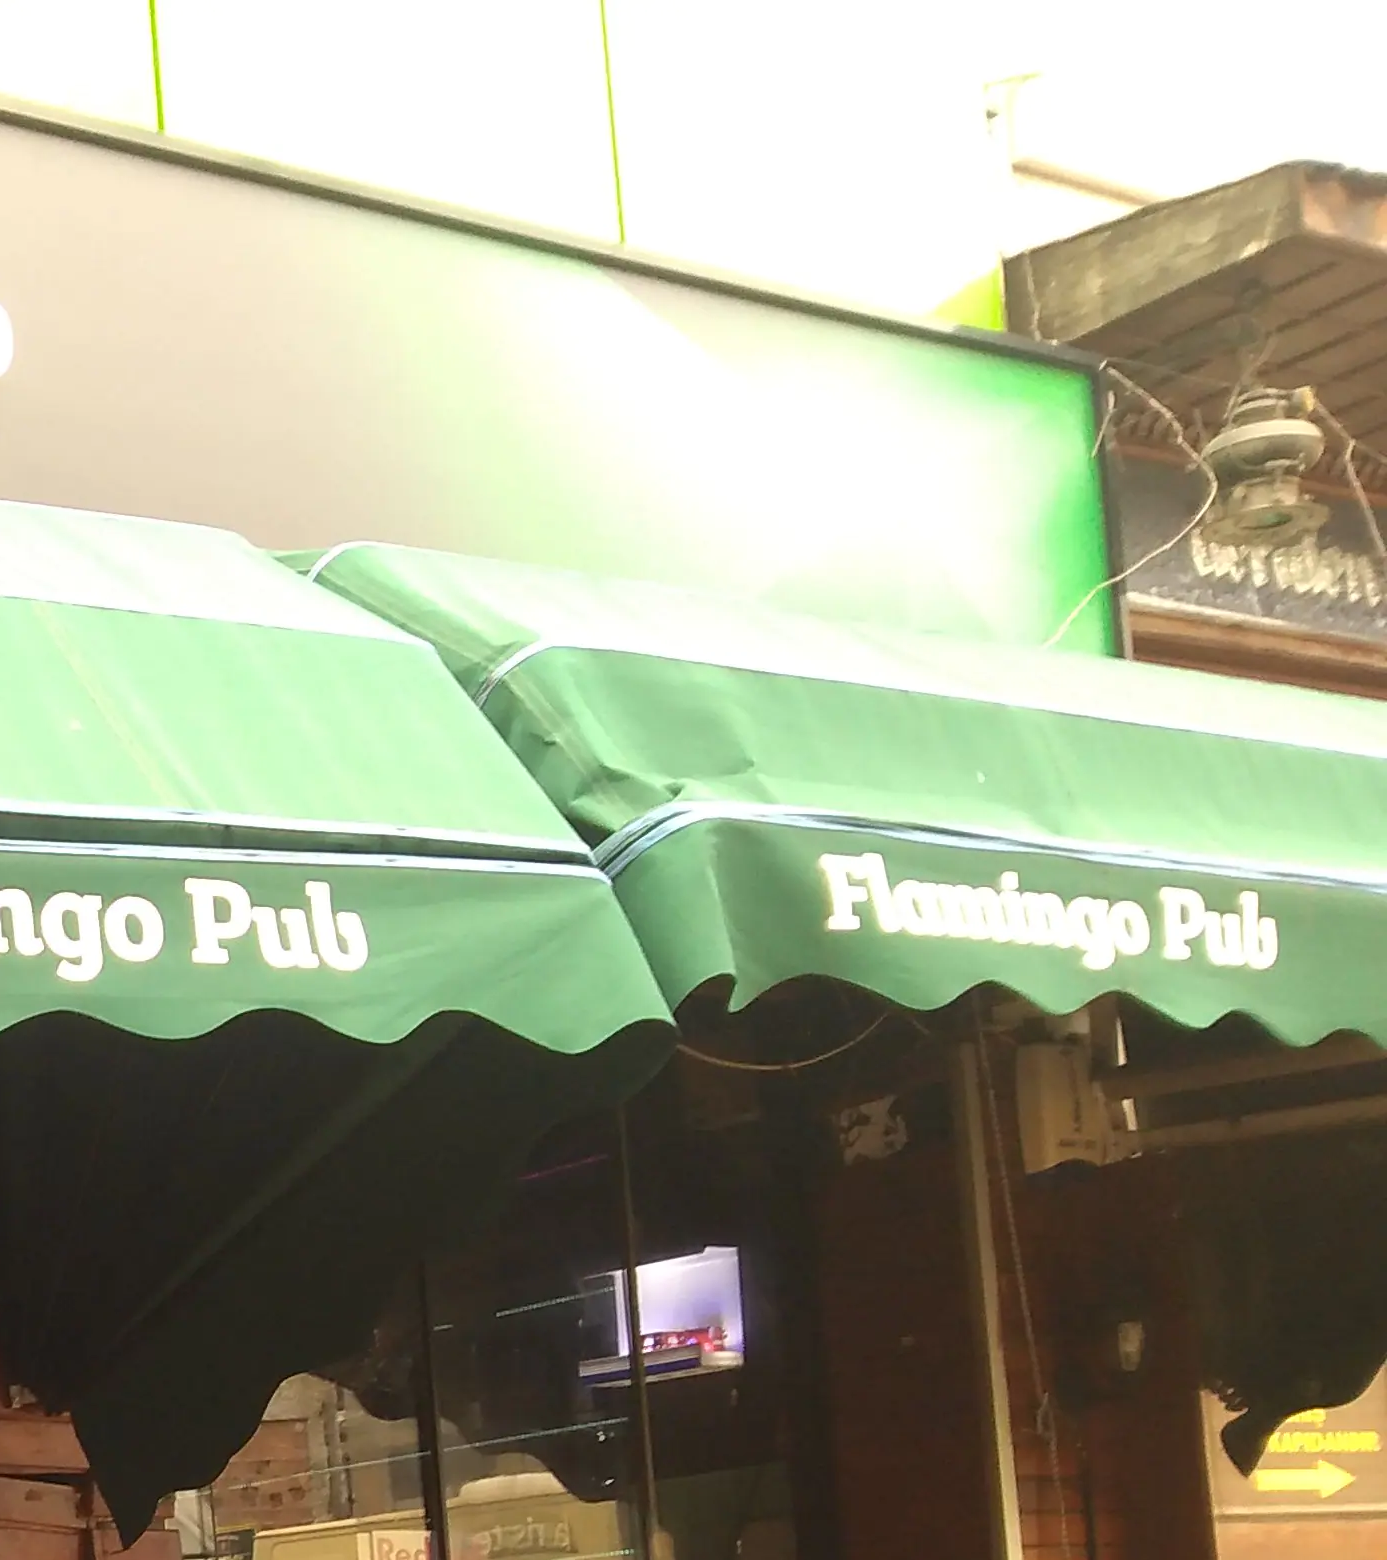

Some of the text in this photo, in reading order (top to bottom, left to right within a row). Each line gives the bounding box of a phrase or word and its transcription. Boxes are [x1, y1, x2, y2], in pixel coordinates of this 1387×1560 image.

[183, 877, 370, 973] Pub
[818, 852, 1280, 971] Flamingo Pub
